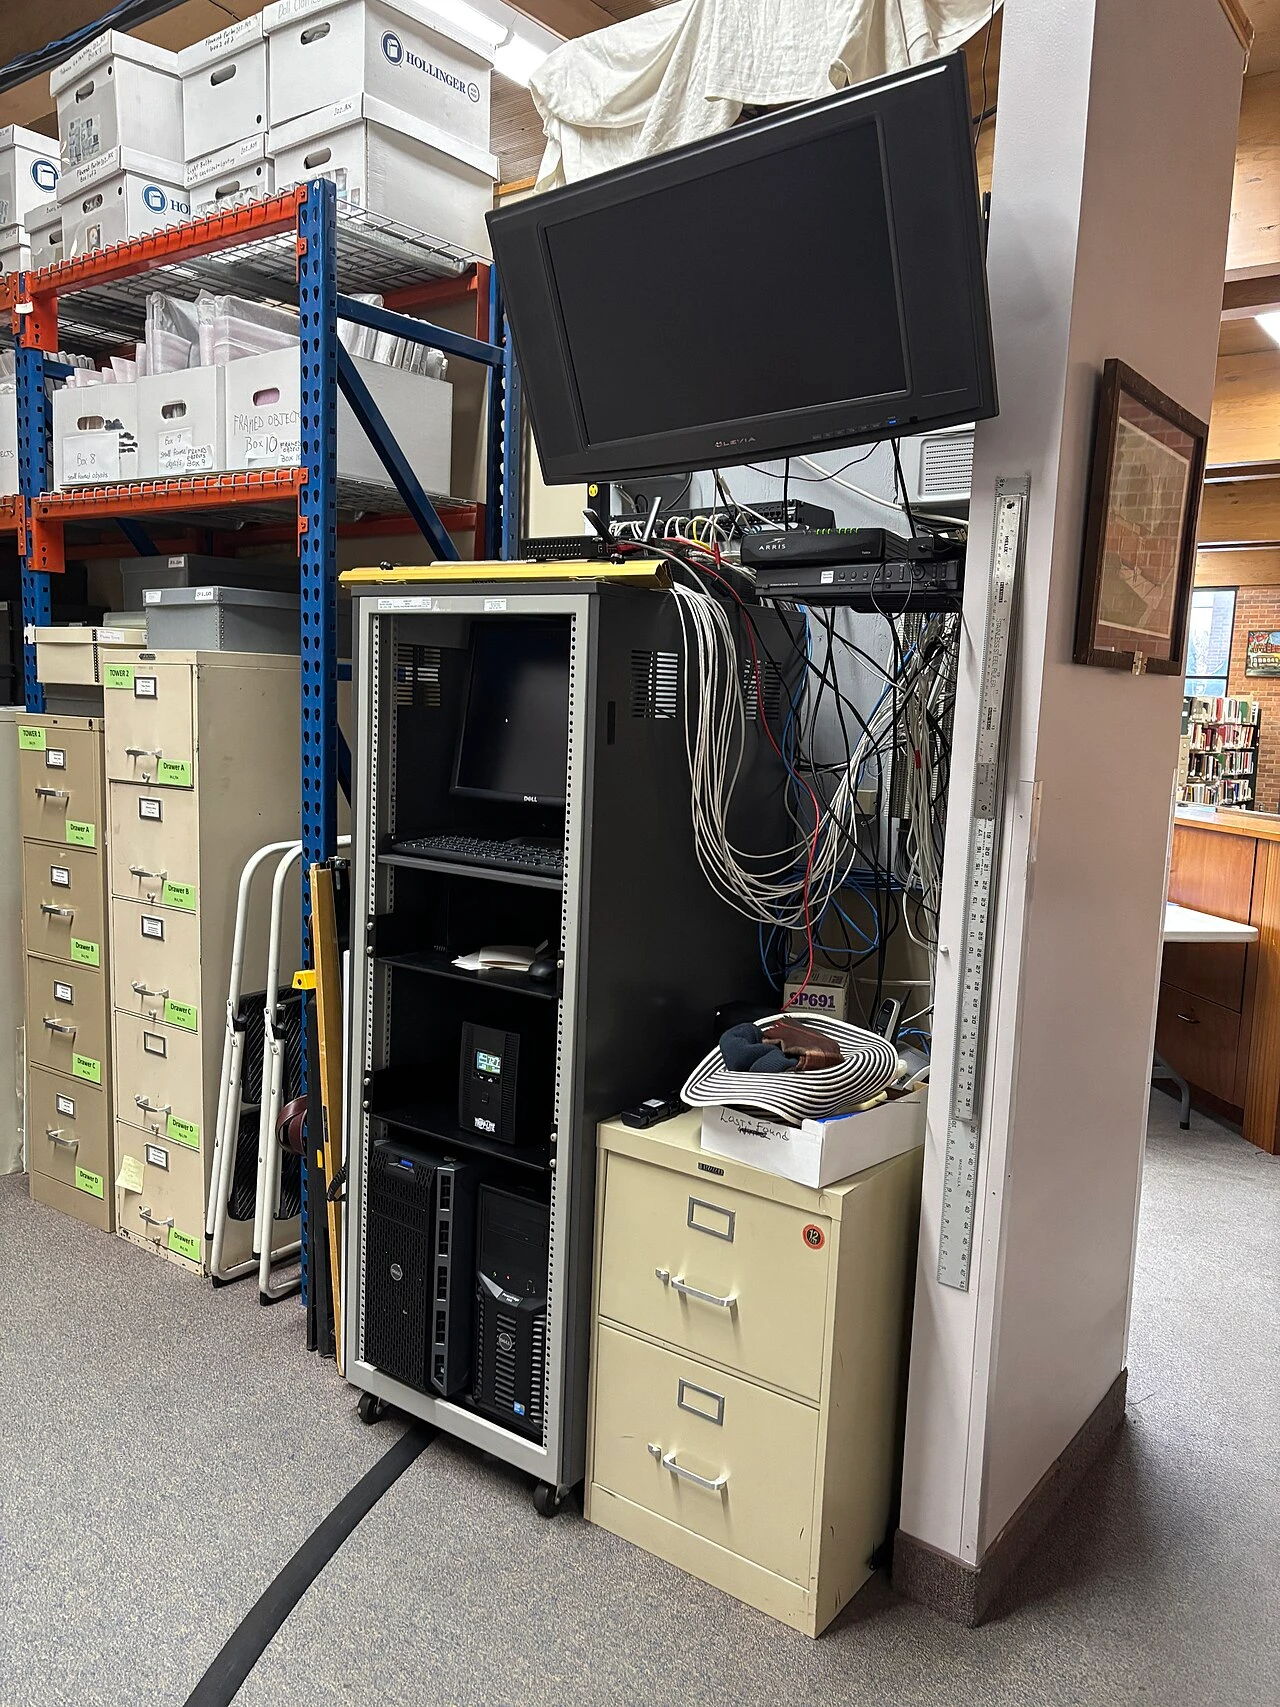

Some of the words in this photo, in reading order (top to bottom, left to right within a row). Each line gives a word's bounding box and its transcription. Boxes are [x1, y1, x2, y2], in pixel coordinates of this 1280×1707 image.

[406, 51, 466, 94] HOLLINGER
[234, 414, 264, 435] FRAMED
[245, 436, 263, 453] Box
[265, 434, 278, 455] 10
[90, 453, 96, 464] 8
[758, 543, 786, 551] ARRIS
[993, 618, 1002, 648] STAINLESS
[992, 649, 1000, 667] STEEL
[109, 669, 126, 677] TOWER
[23, 729, 37, 737] TOWER
[163, 762, 180, 771] Drawer
[70, 824, 85, 833] Drawer
[985, 847, 990, 856] 20
[984, 864, 989, 872] 21
[168, 884, 184, 894] Drawer
[982, 881, 988, 890] 22
[981, 898, 986, 907] 23
[979, 915, 985, 924] 24
[978, 931, 984, 940] 25
[75, 942, 91, 951] Drawer
[977, 948, 982, 957] 26
[975, 965, 981, 974] 27
[974, 982, 980, 991] 28
[789, 992, 835, 1009] SP691
[973, 999, 978, 1008] 29
[170, 1003, 187, 1014] Drawer
[971, 1015, 977, 1024] 30
[970, 1032, 975, 1040] 31
[969, 1048, 974, 1057] 32
[77, 1057, 91, 1067] Drawer
[968, 1065, 973, 1074] 33
[967, 1082, 971, 1091] 34
[965, 1098, 970, 1107] 35
[172, 1119, 189, 1131] Drawer
[756, 1122, 789, 1141] Found
[80, 1170, 94, 1181] Drawer
[174, 1231, 190, 1245] Drawer
[809, 1229, 818, 1240] 12
